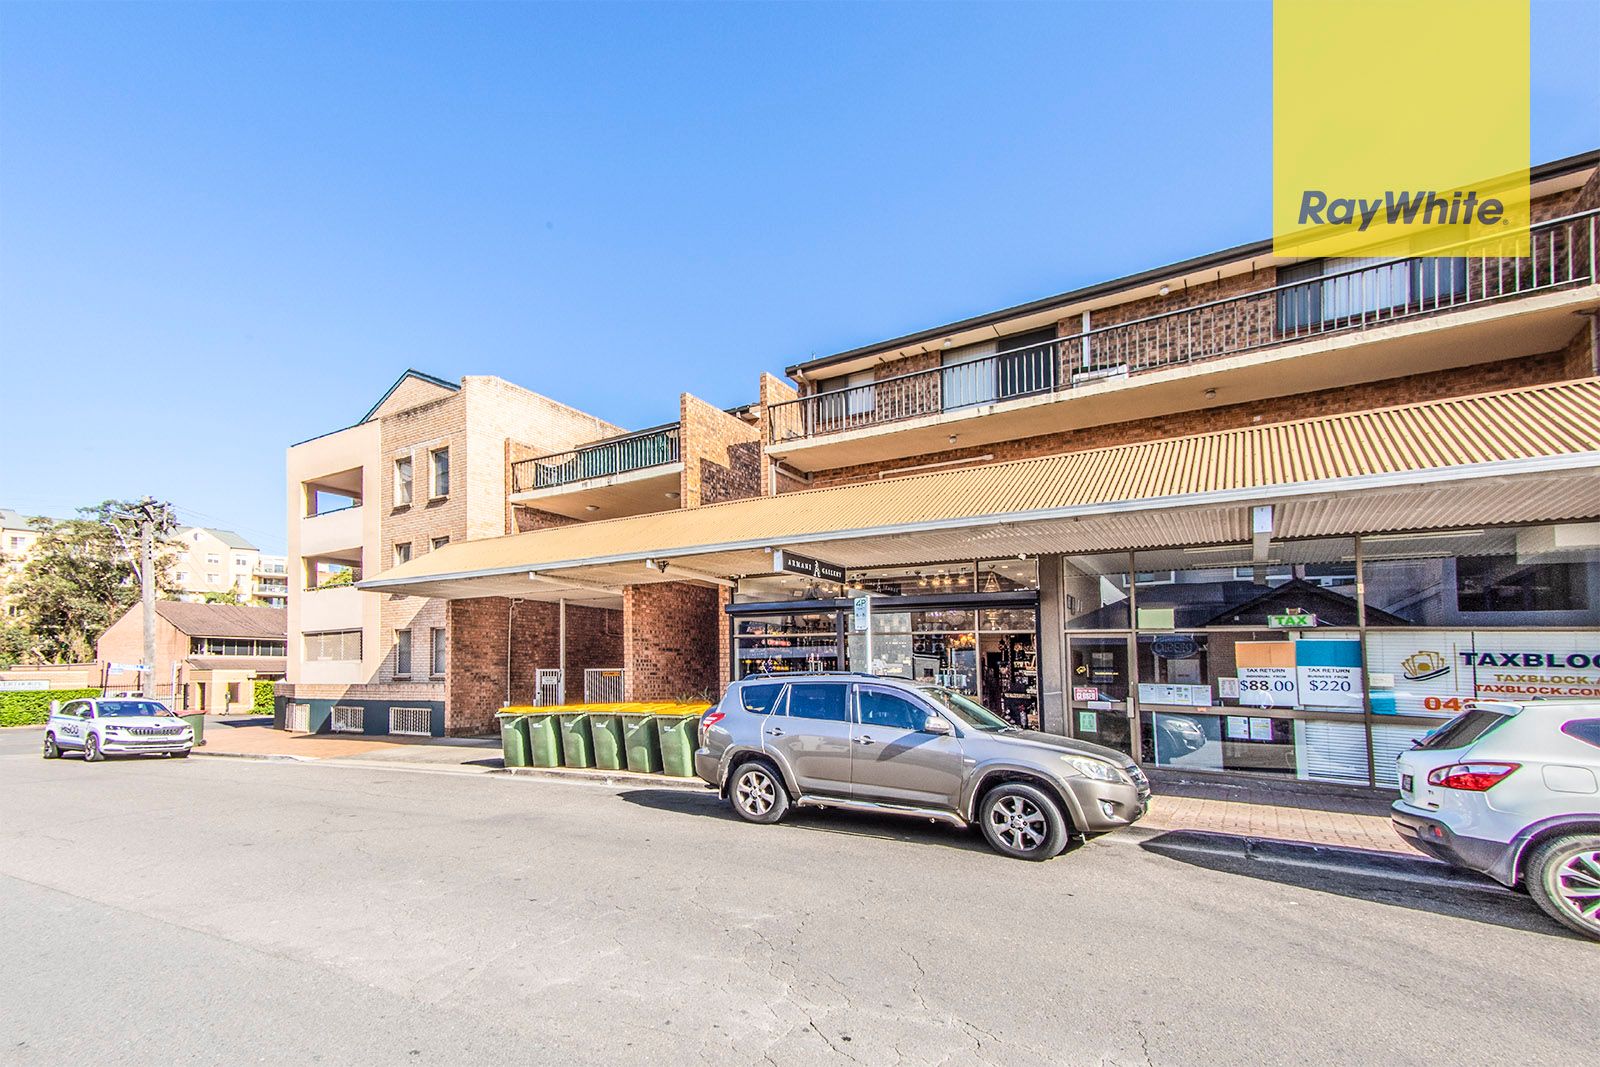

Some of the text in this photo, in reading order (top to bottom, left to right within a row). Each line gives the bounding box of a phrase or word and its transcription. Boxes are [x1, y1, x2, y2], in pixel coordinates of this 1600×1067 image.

[788, 559, 842, 578] ARMANI GALLERY
[1275, 616, 1307, 625] TAX
[1494, 674, 1600, 685] TAXBLOCK.
[1240, 680, 1294, 692] $88.00
[1309, 680, 1351, 692] $220
